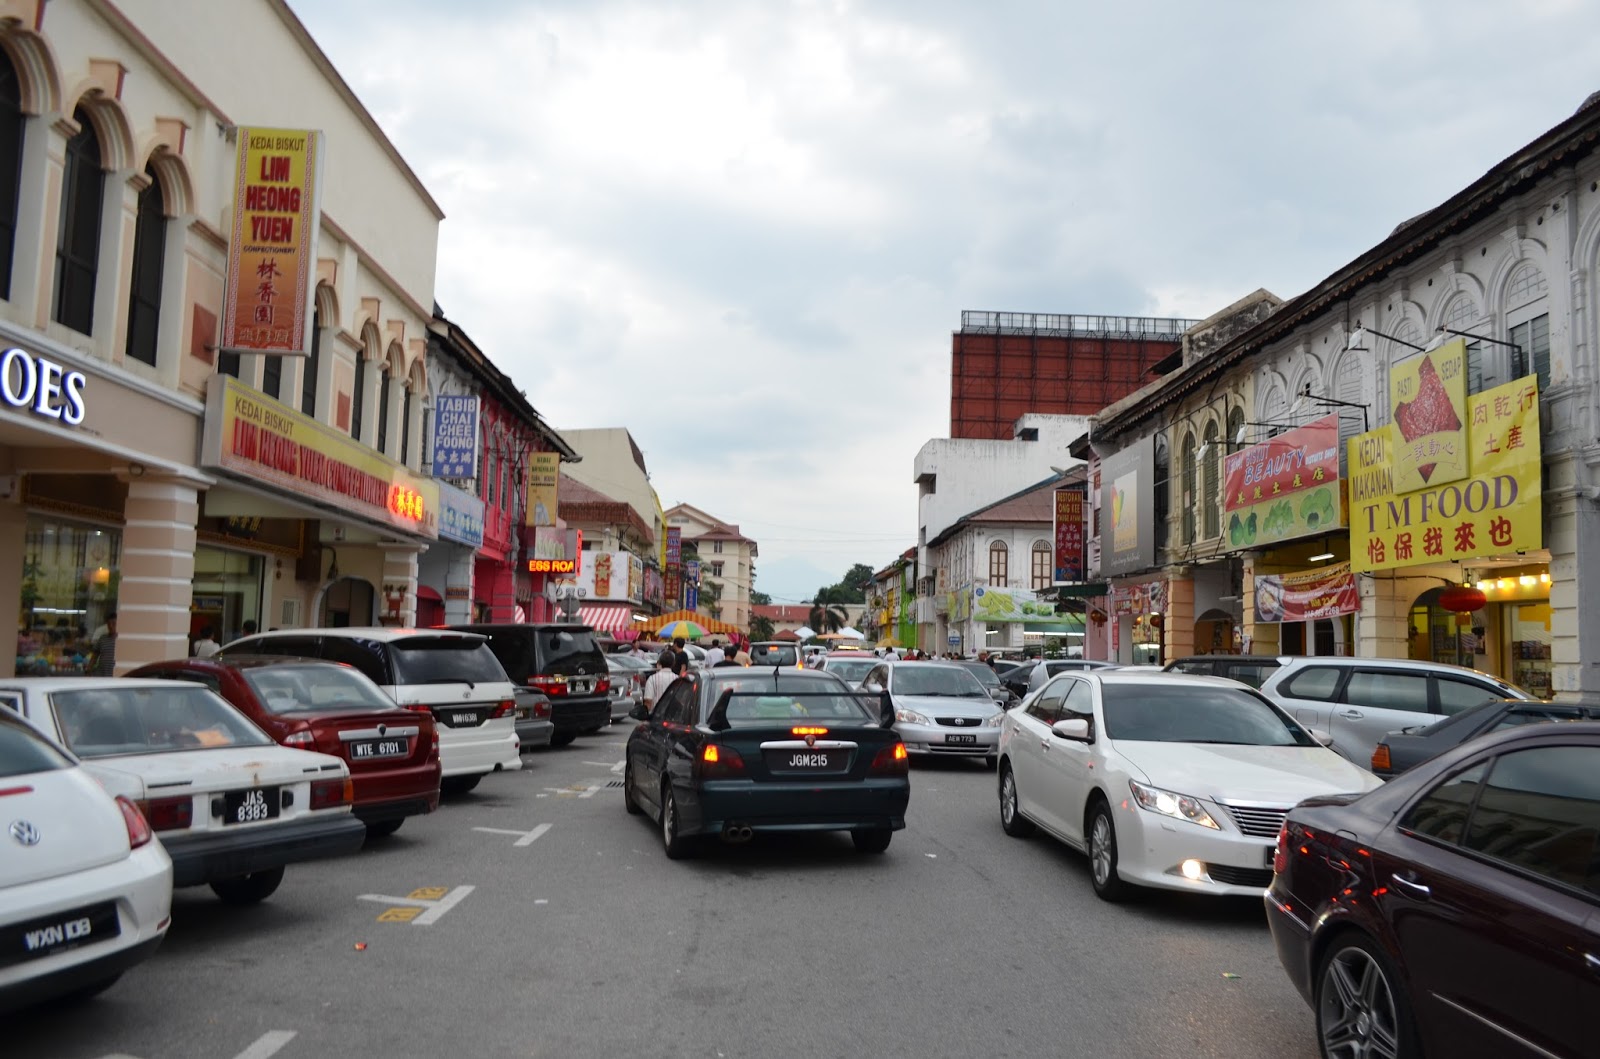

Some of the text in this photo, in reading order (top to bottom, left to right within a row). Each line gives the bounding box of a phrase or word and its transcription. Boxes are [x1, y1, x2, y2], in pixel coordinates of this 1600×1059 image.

[250, 136, 305, 151] KEDAI BISKUT
[260, 155, 291, 182] LIM
[245, 185, 301, 213] HEONG
[251, 215, 293, 243] YUEN
[243, 245, 296, 254] CONFECTIONERY
[1441, 356, 1462, 381] SEDAP
[0, 348, 86, 425] OES
[1397, 377, 1412, 398] PASTI
[235, 396, 294, 436] KEDAI BISKUT
[438, 398, 476, 412] TABIB
[439, 424, 472, 437] CHEE
[441, 412, 471, 425] CHAI
[233, 416, 258, 461] LIM
[259, 428, 298, 476] HEONG
[300, 445, 326, 486] YUEN
[436, 436, 473, 449] FOONG
[1359, 435, 1385, 469] KEDAI
[1244, 445, 1308, 486] BEAUTY
[1352, 467, 1394, 501] MAKANAN
[1057, 492, 1081, 502] RESTORAN
[1419, 474, 1519, 524] FOOD
[1367, 515, 1513, 565] 怡保我來也
[529, 560, 551, 572] ESS
[356, 741, 399, 756] WTE 6701
[242, 790, 264, 806] JAS
[238, 803, 268, 821] 8383
[25, 924, 64, 950] WXN
